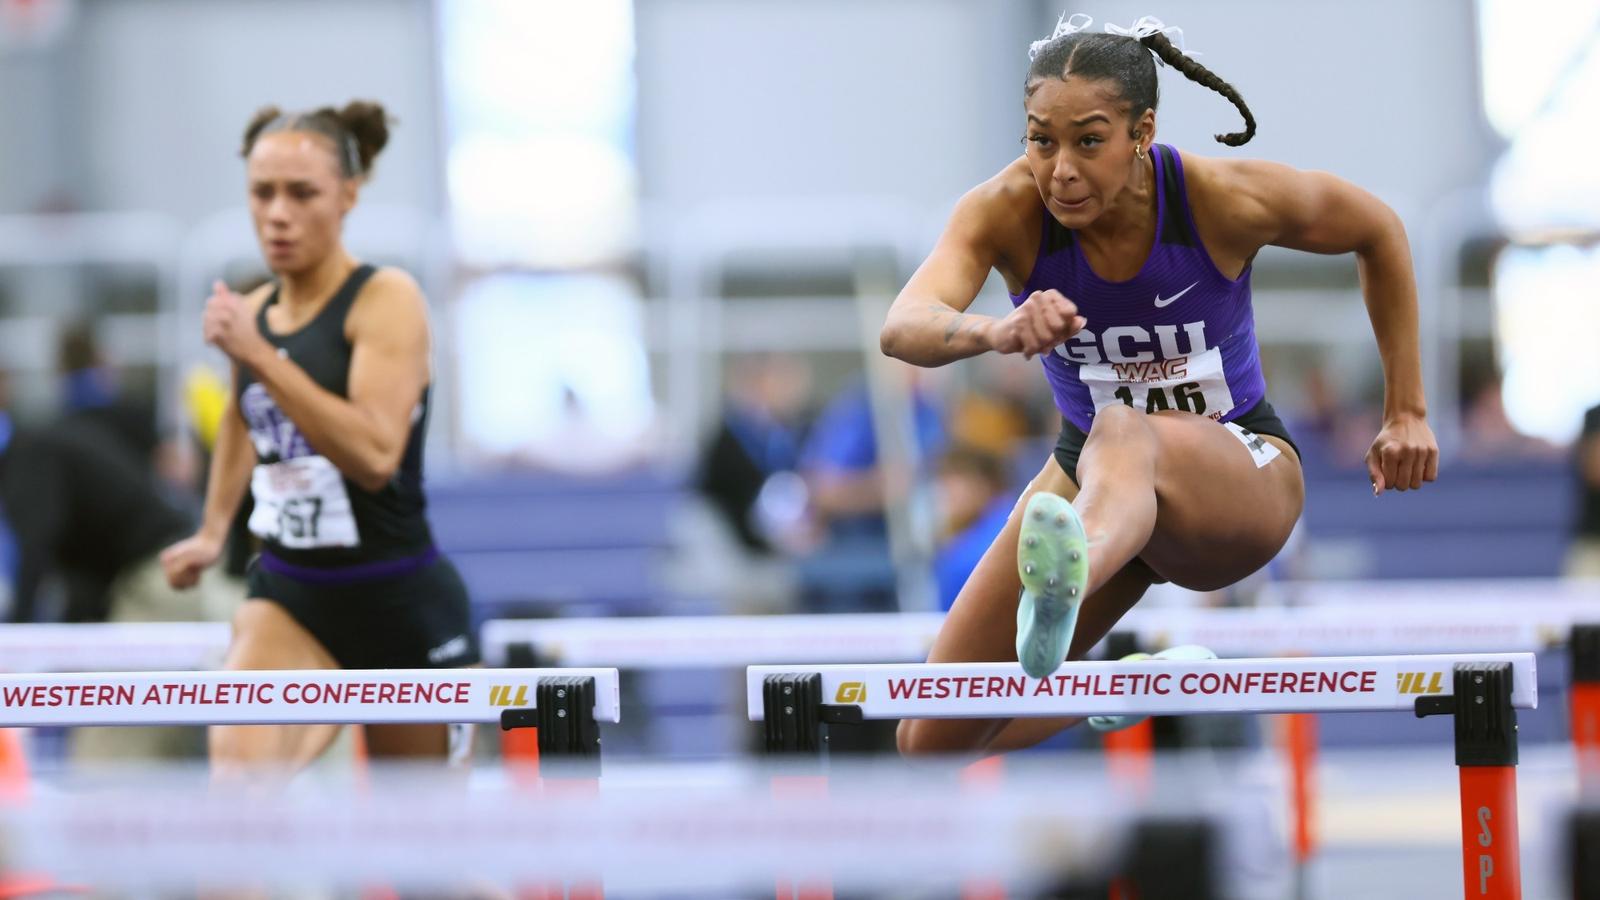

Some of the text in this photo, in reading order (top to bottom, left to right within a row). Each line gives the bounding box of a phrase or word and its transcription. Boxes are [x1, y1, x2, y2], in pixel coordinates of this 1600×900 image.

[1054, 320, 1206, 364] GCU
[1112, 357, 1188, 380] WAC
[1114, 381, 1207, 415] 146
[3, 682, 471, 707] WESTERN ATHLETIC CONFERENCE
[888, 671, 1377, 699] WESTERN ATHLETIC CONFERENCE
[1397, 672, 1443, 694] ILL
